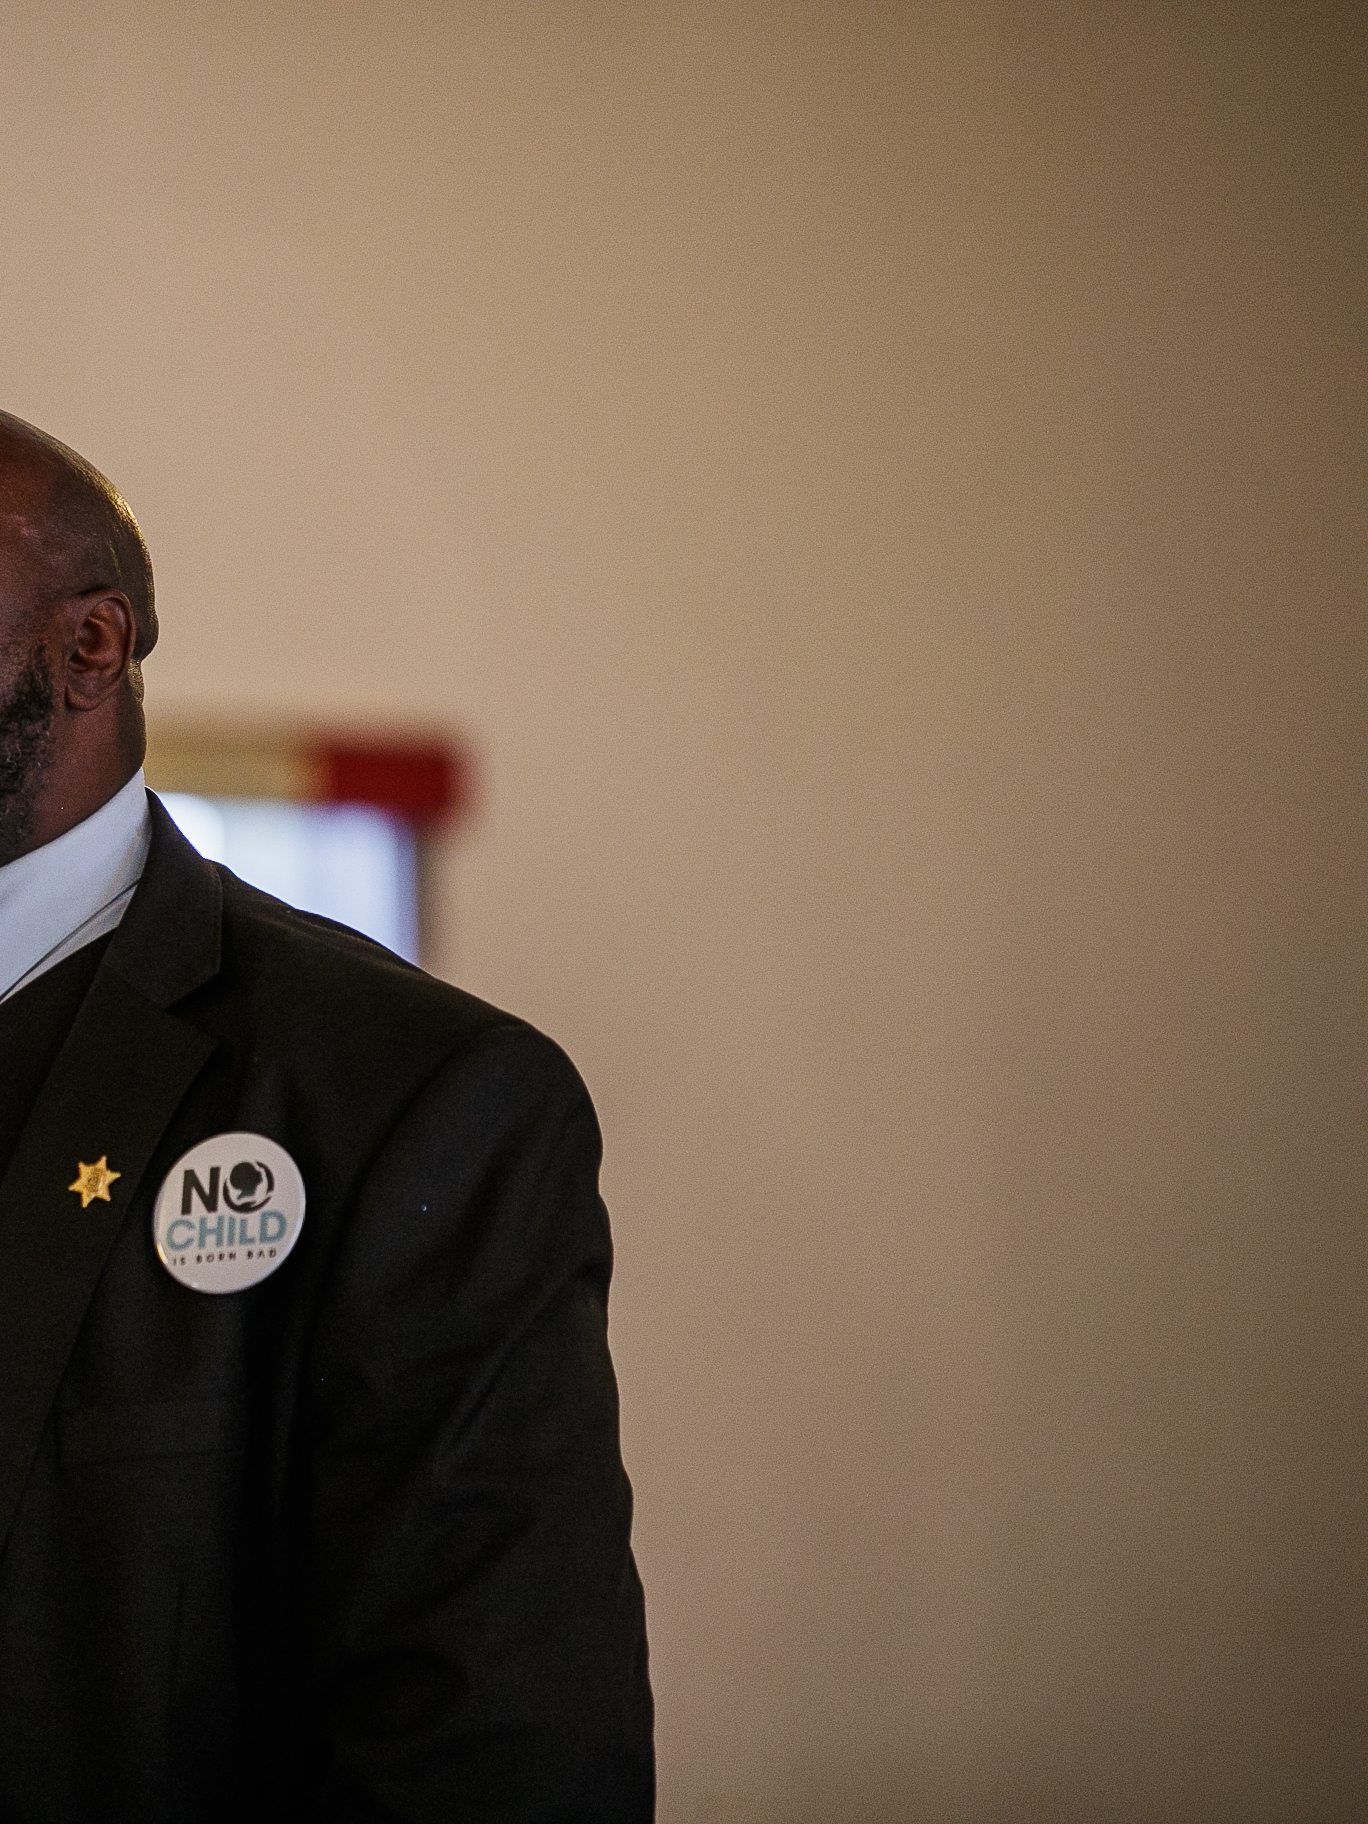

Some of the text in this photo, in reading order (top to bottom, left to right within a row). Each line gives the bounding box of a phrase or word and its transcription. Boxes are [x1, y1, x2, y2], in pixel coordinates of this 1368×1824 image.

[181, 1161, 275, 1215] NO
[166, 1211, 288, 1251] CHILD
[172, 1247, 278, 1266] IS BORN BAD
